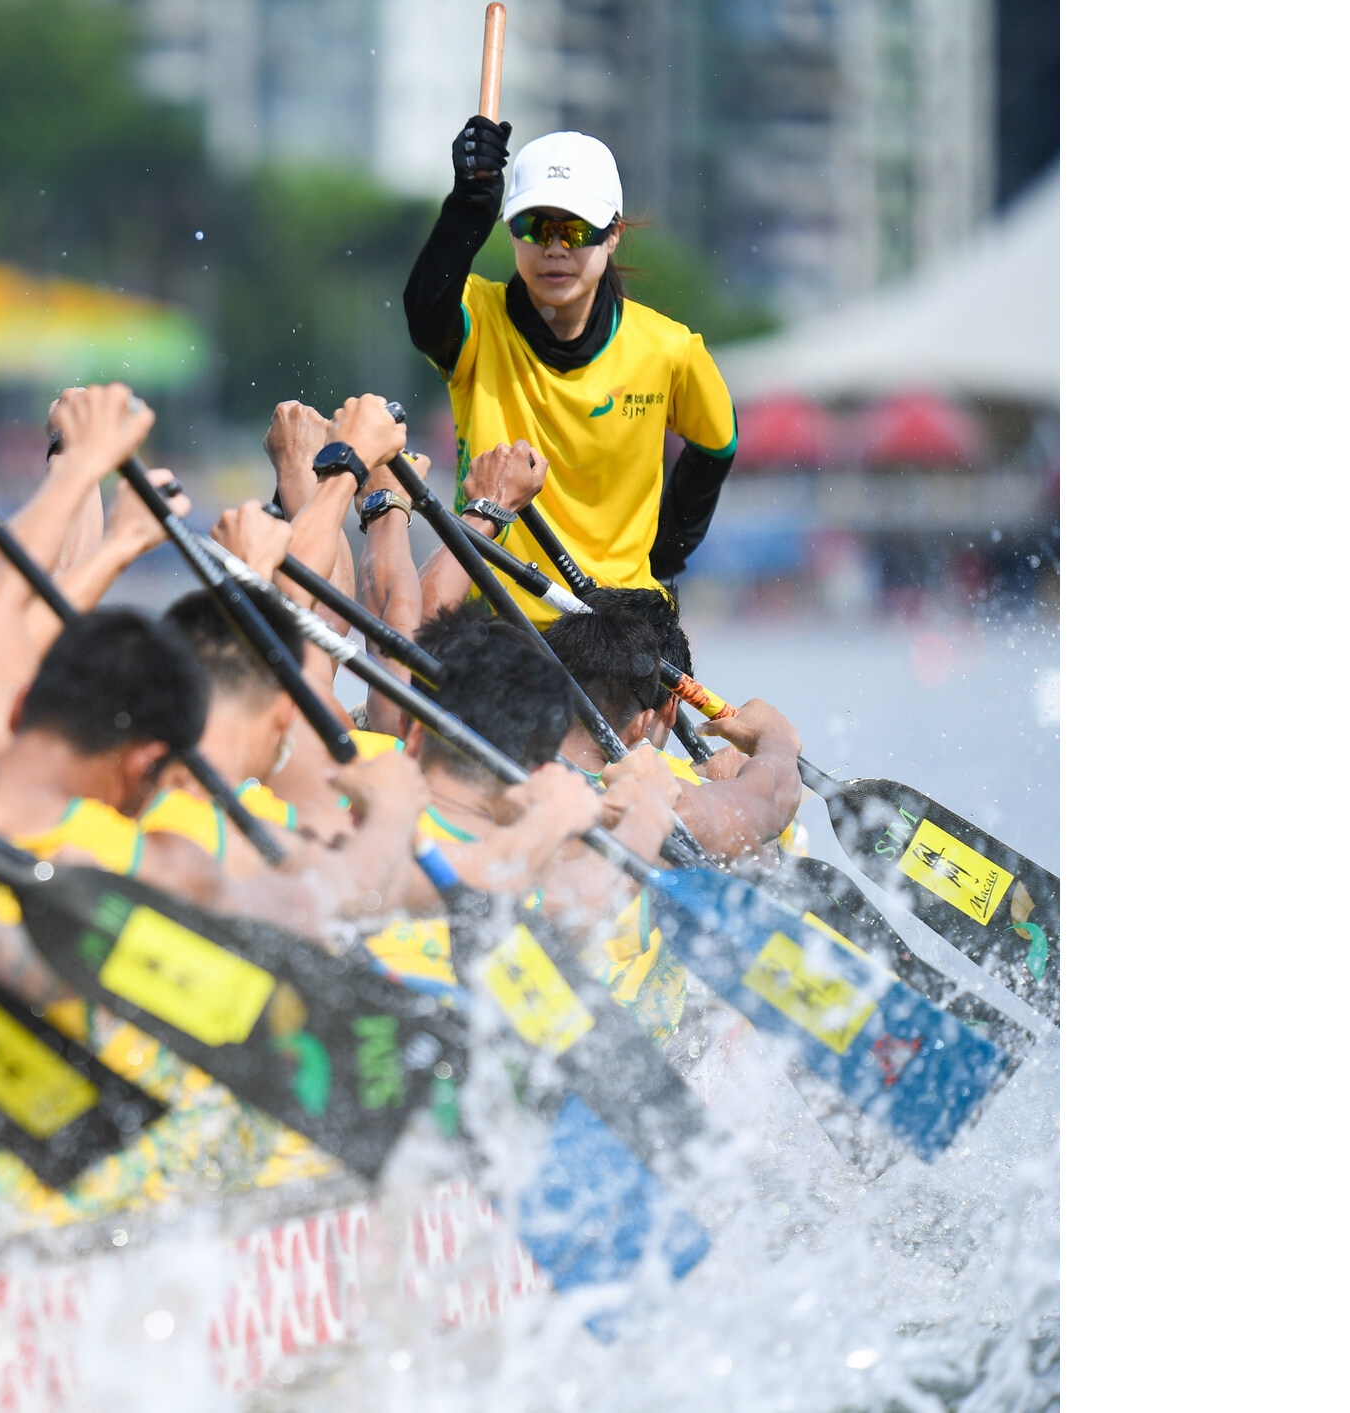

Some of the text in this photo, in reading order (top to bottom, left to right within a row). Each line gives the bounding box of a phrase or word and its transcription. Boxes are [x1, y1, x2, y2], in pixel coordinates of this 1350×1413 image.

[622, 406, 646, 419] SJM
[874, 806, 920, 862] SJM
[969, 869, 999, 919] Macau
